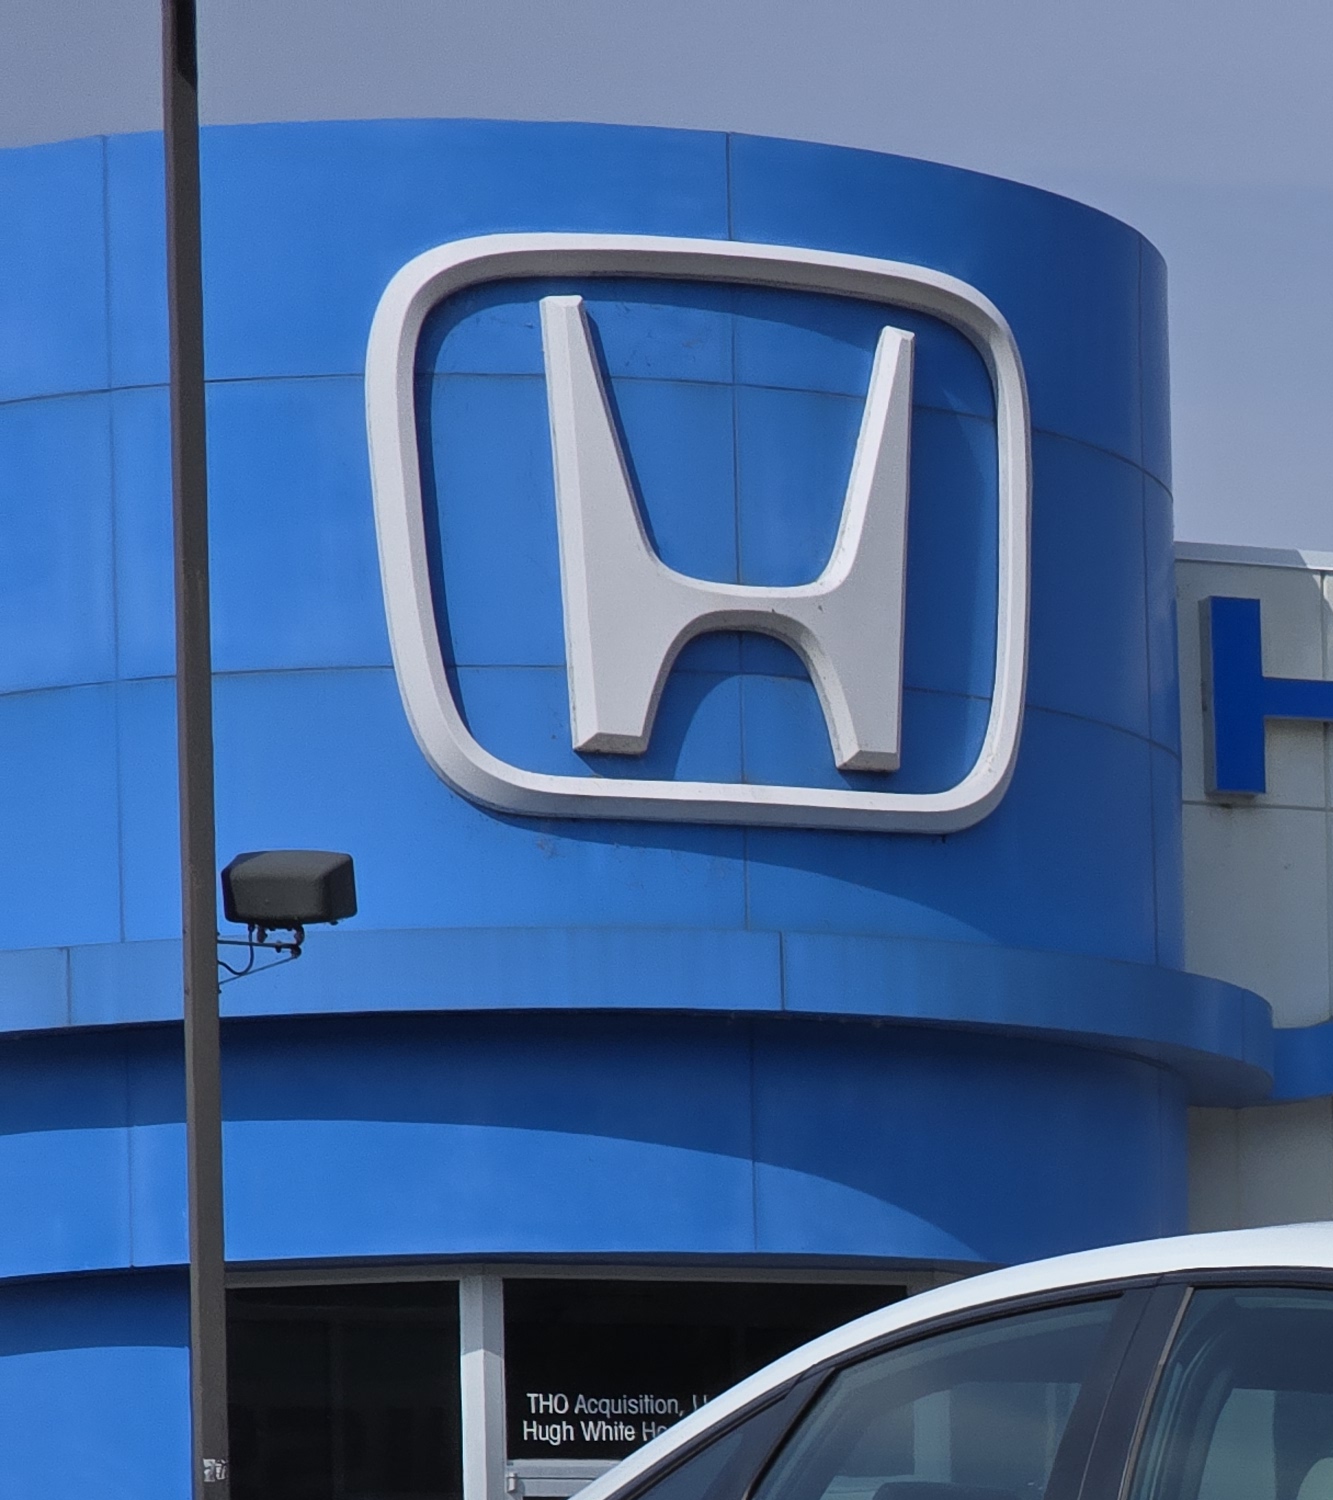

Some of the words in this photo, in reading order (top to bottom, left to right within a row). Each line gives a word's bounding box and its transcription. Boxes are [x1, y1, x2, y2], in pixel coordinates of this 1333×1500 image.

[526, 1393, 569, 1414] THO
[574, 1394, 685, 1418] Acquisition,
[522, 1420, 575, 1446] Hugh
[580, 1420, 636, 1441] White
